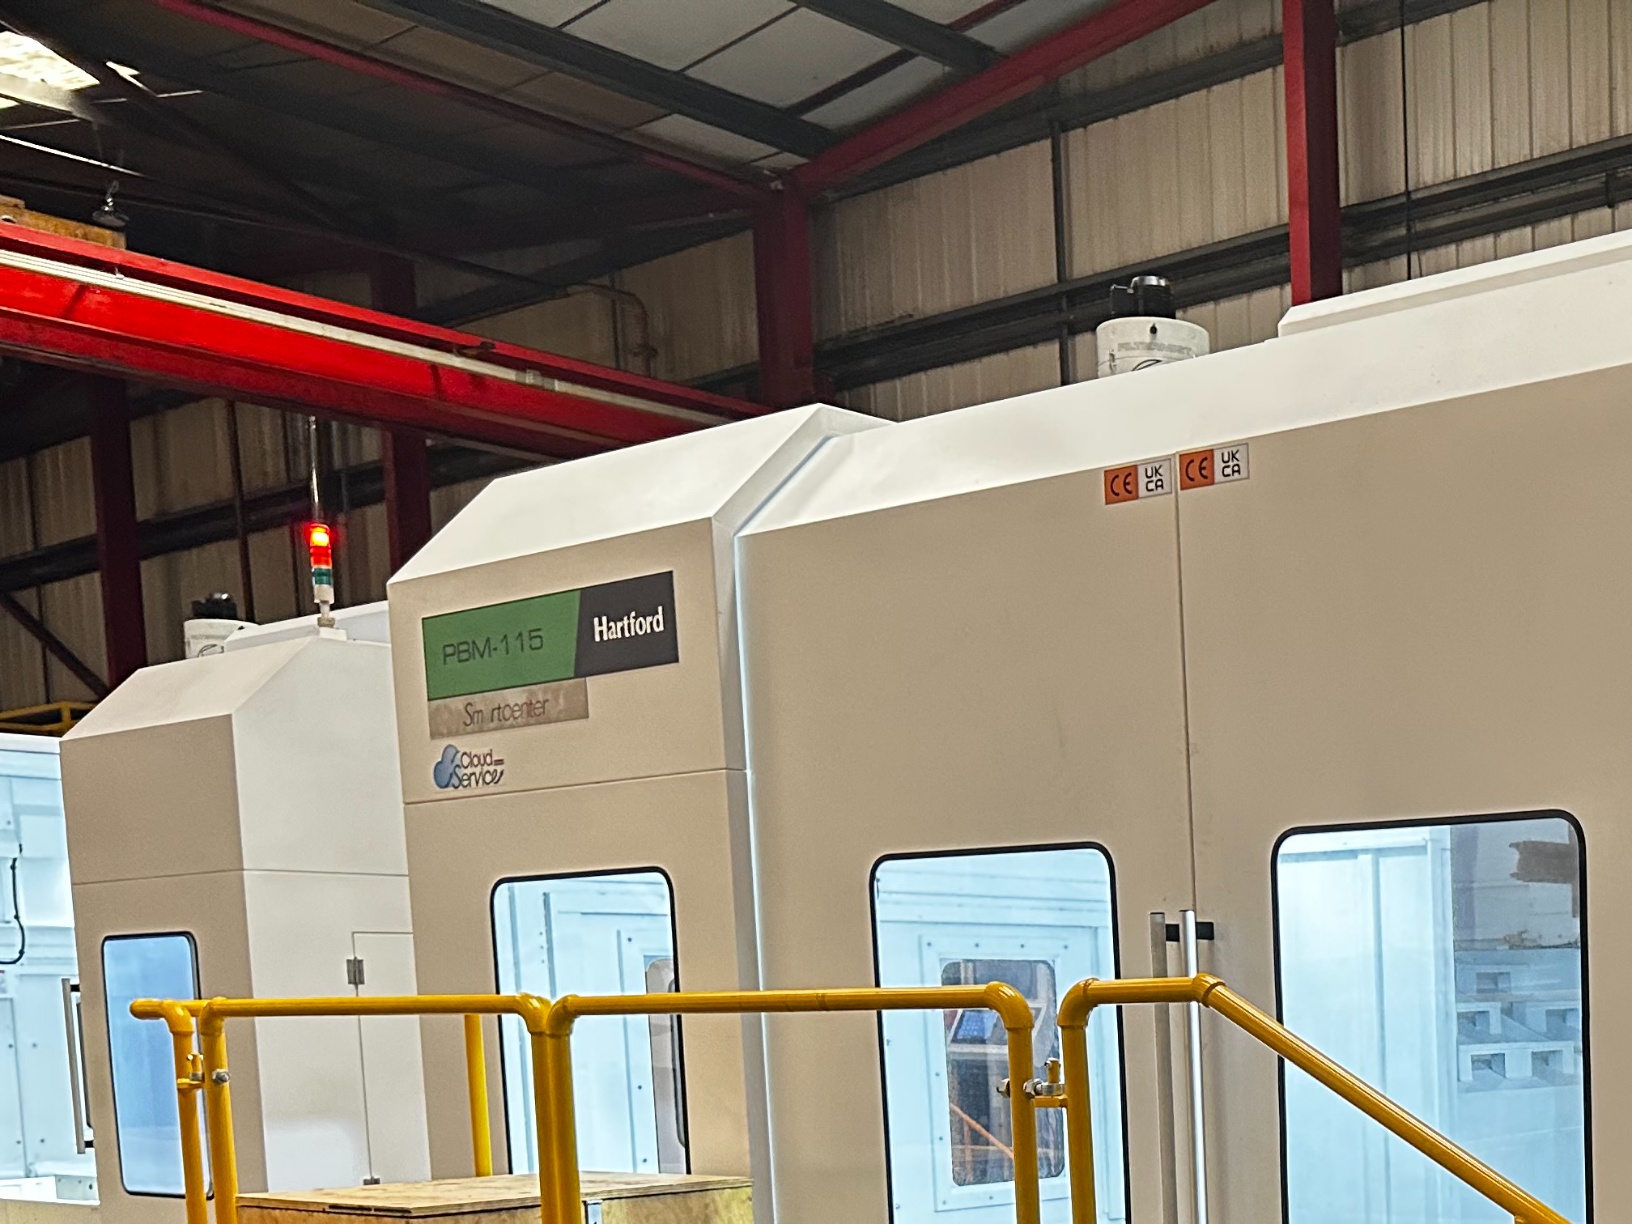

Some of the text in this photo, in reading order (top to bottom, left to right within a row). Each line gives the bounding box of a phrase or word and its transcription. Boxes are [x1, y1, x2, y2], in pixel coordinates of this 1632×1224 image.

[1221, 449, 1239, 464] UK
[1144, 464, 1163, 478] UK
[1185, 456, 1209, 481] CE
[1221, 463, 1241, 477] CA
[1110, 472, 1133, 496] CE
[1145, 478, 1164, 492] CA
[594, 606, 665, 642] Hartford
[442, 628, 544, 665] PBM-115
[463, 698, 550, 727] Smrtcenter
[460, 748, 493, 769] Cloud
